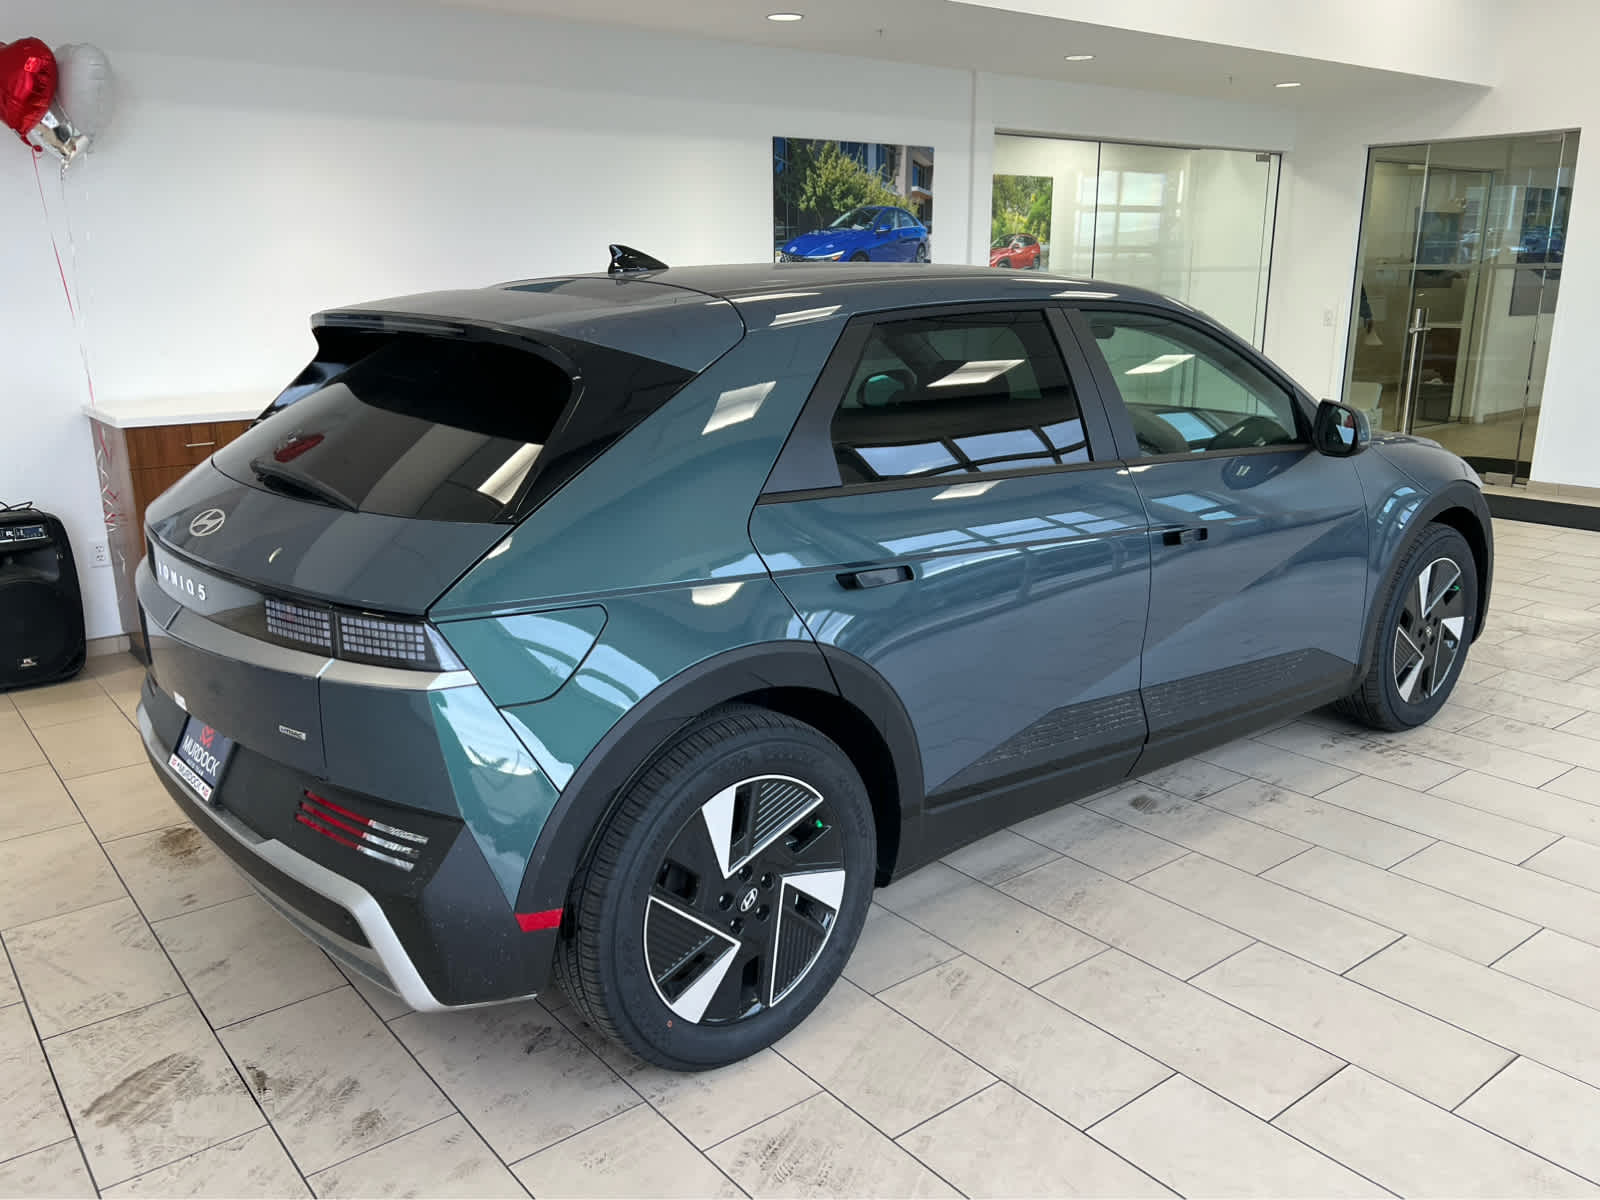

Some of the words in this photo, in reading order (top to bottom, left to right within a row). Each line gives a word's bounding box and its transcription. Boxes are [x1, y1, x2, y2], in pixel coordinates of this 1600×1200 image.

[158, 561, 195, 596] IONIQ
[197, 583, 207, 601] 5
[182, 735, 221, 777] MURDOCK
